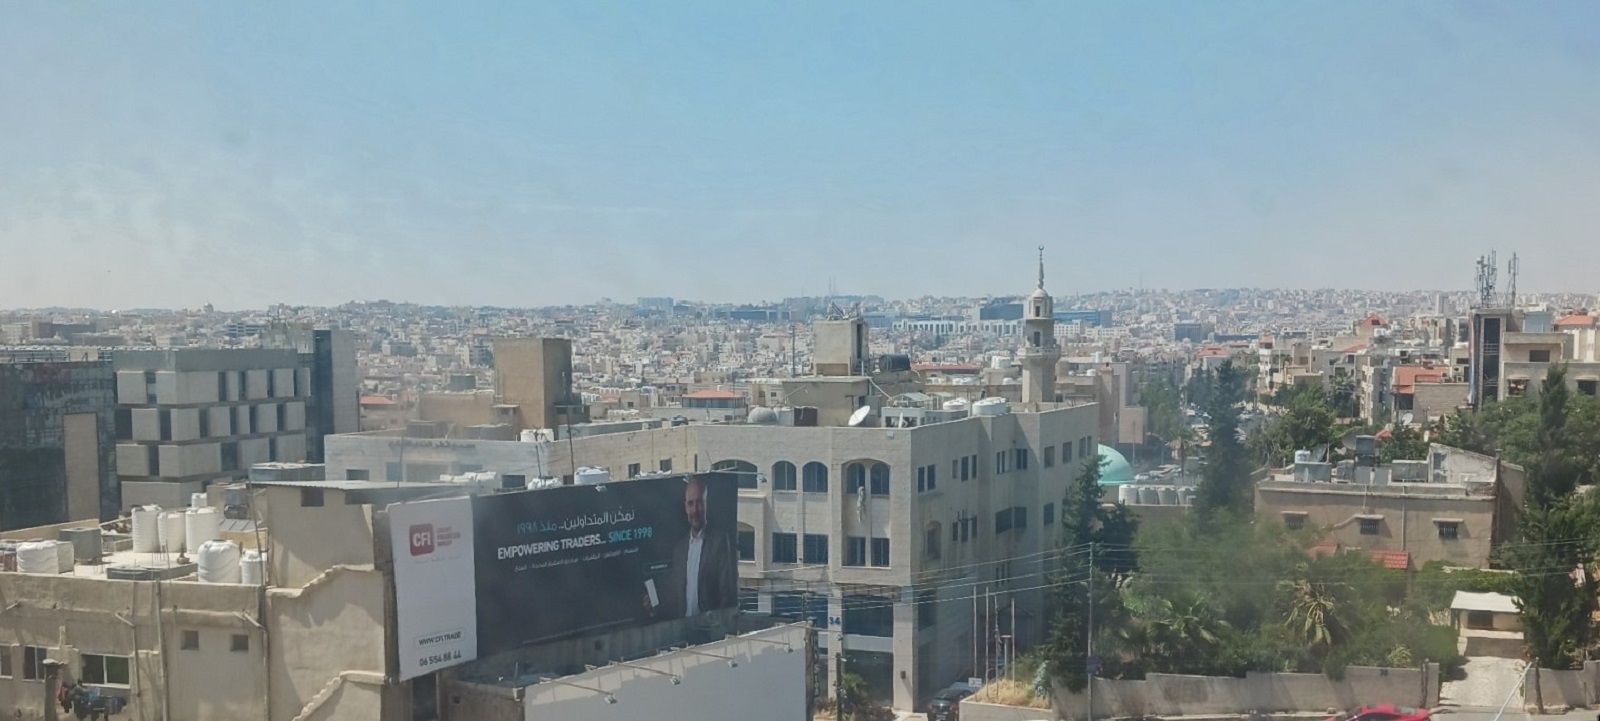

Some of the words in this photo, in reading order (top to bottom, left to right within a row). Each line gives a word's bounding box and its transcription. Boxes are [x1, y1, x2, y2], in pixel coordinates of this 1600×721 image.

[412, 532, 431, 547] CFI
[497, 540, 560, 560] EMPOWERING
[608, 529, 632, 543] SINCE
[633, 526, 653, 539] 1998
